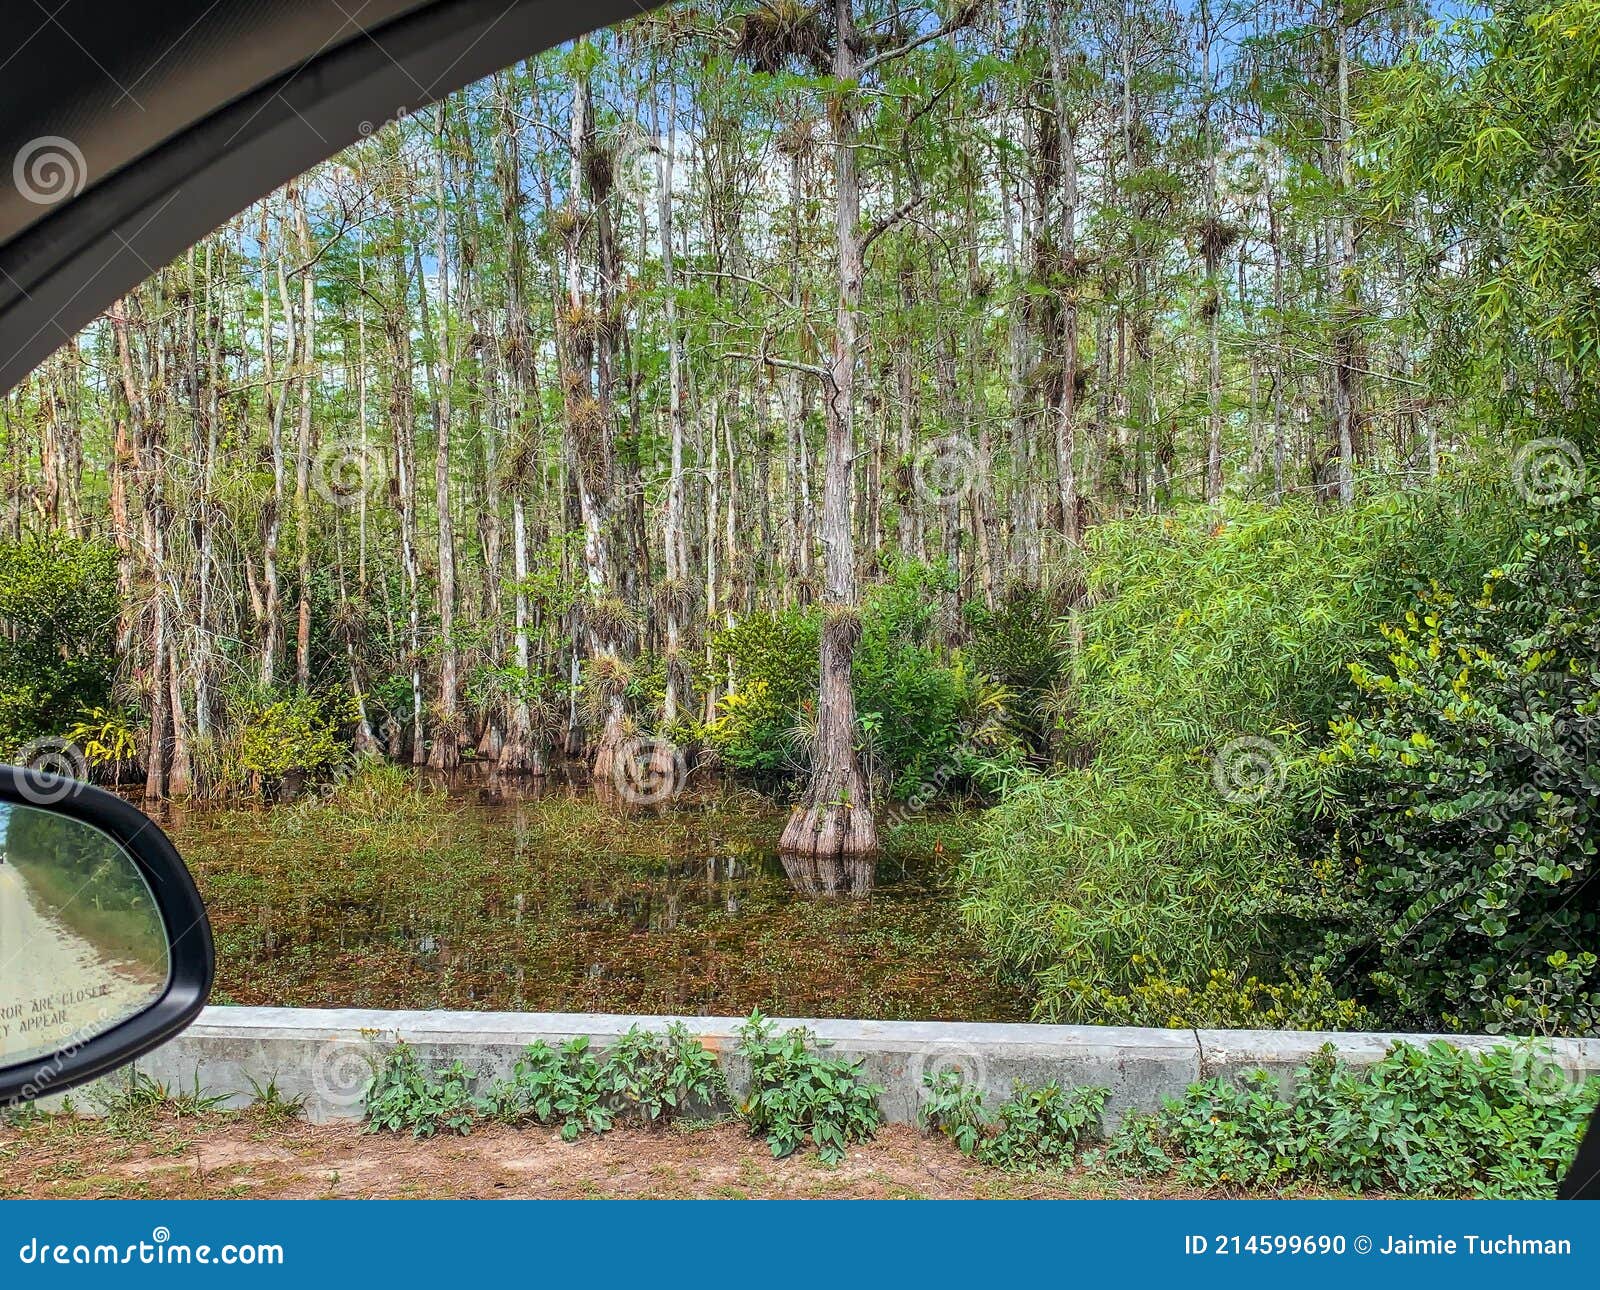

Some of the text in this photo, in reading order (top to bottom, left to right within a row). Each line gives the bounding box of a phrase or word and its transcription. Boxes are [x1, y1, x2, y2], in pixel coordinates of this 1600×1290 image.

[31, 997, 54, 1013] ARE
[62, 984, 111, 1006] CLOSER
[20, 1010, 69, 1033] APPEAR
